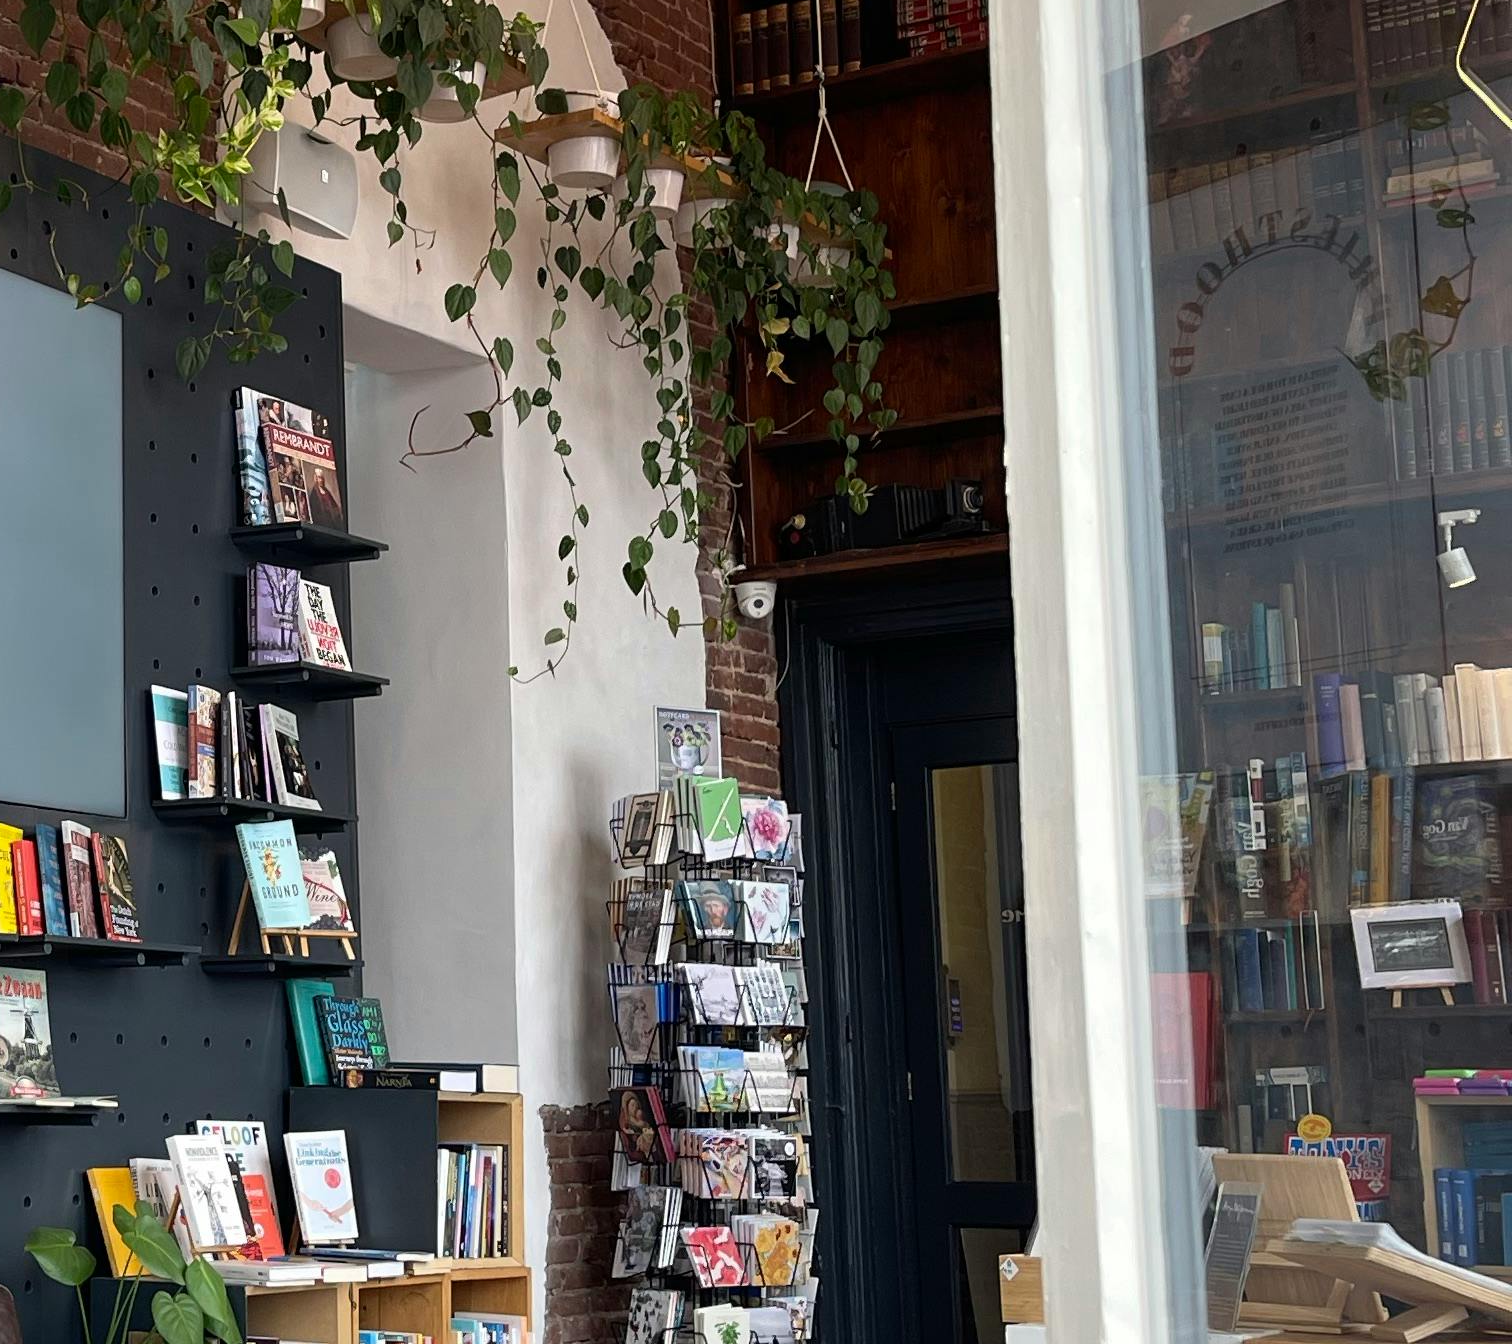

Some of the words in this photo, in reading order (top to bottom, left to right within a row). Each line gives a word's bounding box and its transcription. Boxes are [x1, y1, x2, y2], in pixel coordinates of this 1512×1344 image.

[272, 428, 332, 457] REMBRANDT
[304, 583, 321, 598] THE
[309, 596, 324, 611] DAY
[316, 648, 347, 666] BEGAN
[248, 838, 293, 850] UNCOMMON
[261, 884, 299, 899] GROUND
[304, 882, 338, 903] Wine
[4, 975, 43, 1000] Zwaan
[323, 997, 360, 1017] Through
[326, 1012, 365, 1034] Glass
[332, 1033, 369, 1051] Darkly
[375, 1074, 412, 1088] NARNIA
